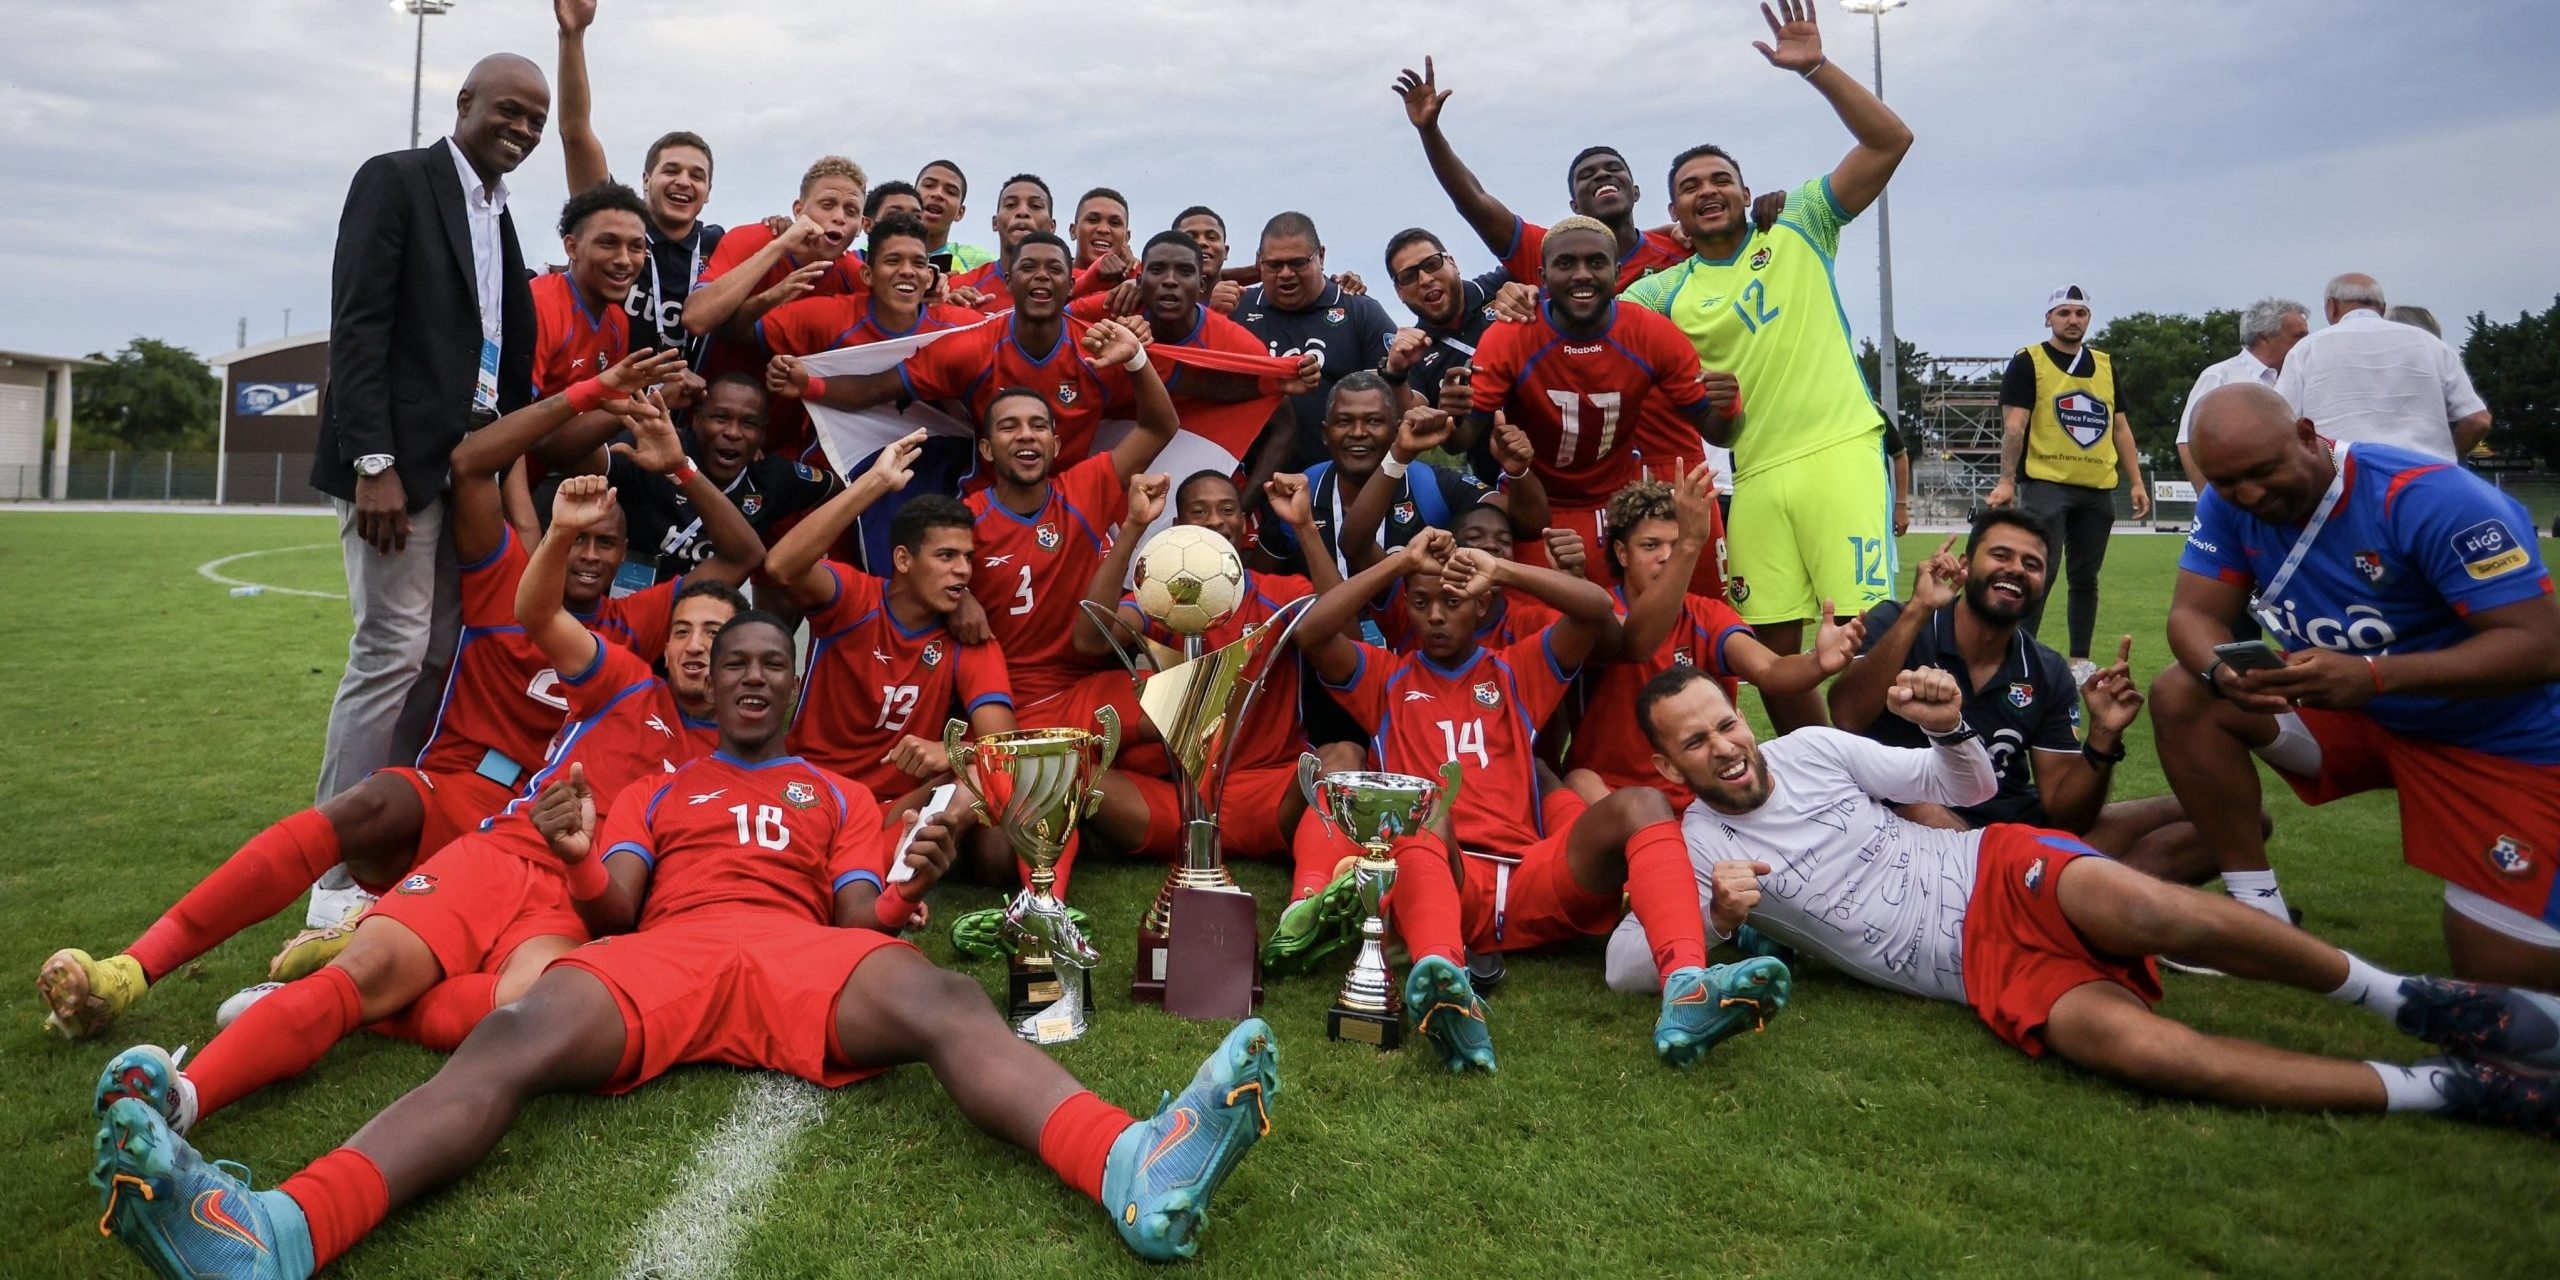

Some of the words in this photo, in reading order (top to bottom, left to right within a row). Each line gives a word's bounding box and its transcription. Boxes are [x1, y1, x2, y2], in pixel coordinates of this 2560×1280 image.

[1733, 278, 1779, 335] 12
[1563, 345, 1603, 355] Reebok
[1546, 389, 1621, 468] 11
[2061, 413, 2082, 422] France
[1847, 536, 1886, 586] 12
[1010, 565, 1034, 615] 3
[874, 685, 919, 731] 13
[1436, 717, 1489, 770] 14
[727, 803, 790, 851] 18
